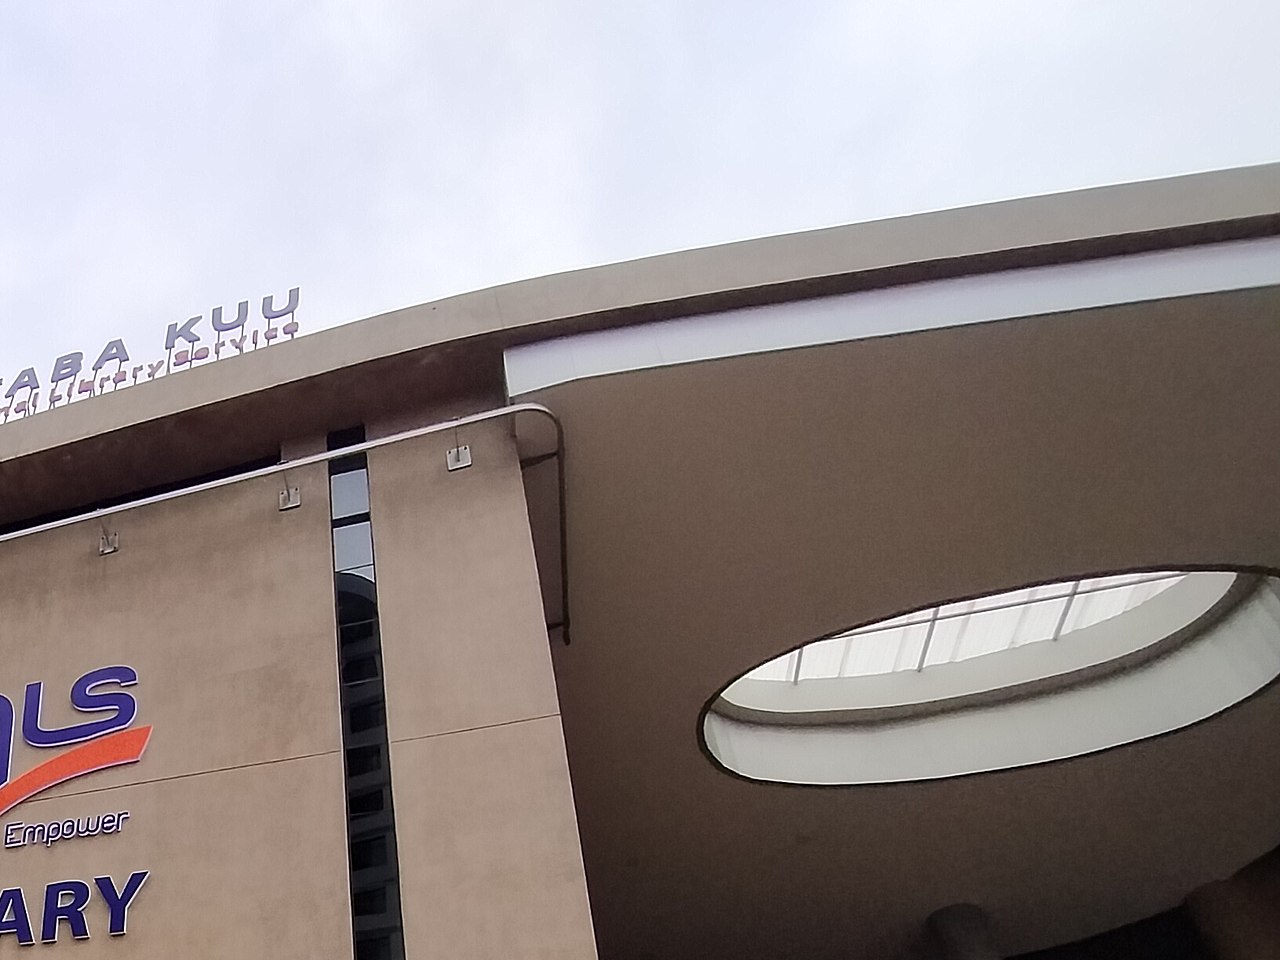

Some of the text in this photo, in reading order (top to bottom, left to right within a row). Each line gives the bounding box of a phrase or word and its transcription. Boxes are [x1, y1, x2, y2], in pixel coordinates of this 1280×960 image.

[164, 286, 300, 351] KUU
[48, 359, 165, 402] Library
[4, 811, 130, 848] Empower
